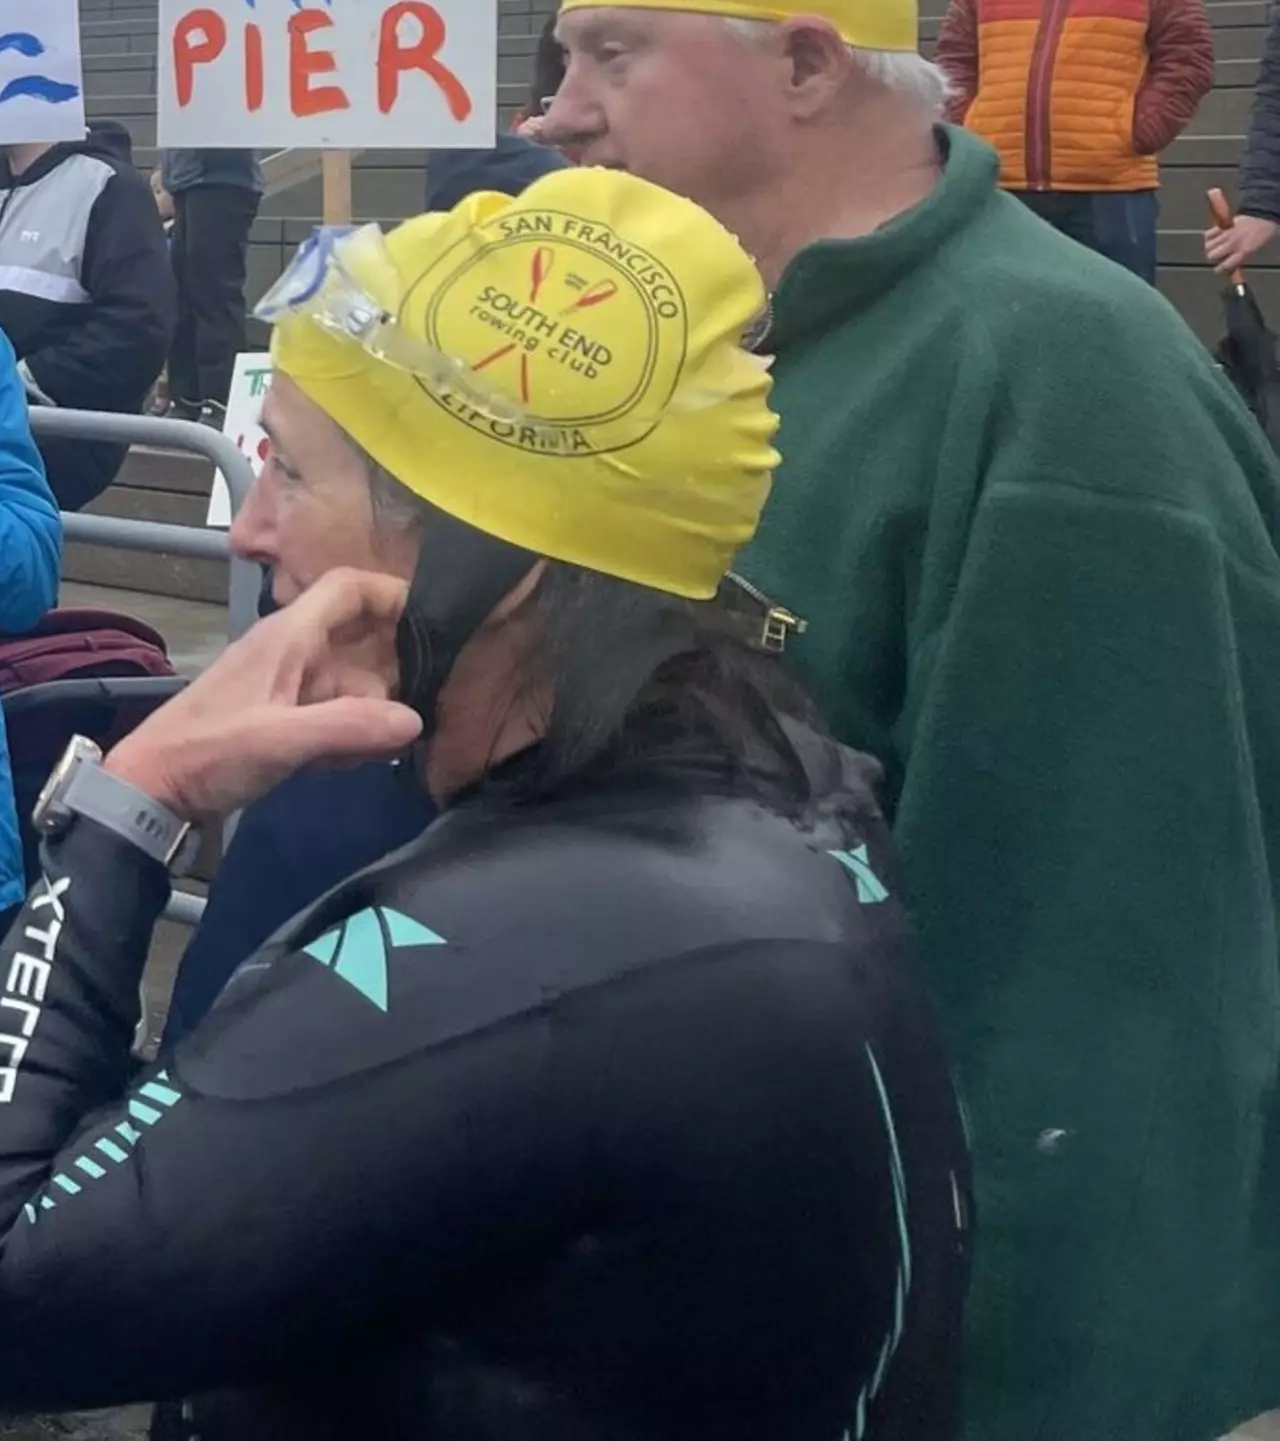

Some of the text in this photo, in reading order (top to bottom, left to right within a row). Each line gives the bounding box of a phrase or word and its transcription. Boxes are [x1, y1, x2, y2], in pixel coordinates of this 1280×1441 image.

[171, 0, 473, 122] PIER
[500, 215, 679, 319] SAN FRANCISCO
[469, 305, 600, 380] rowing club
[476, 285, 613, 367] SOUTH END
